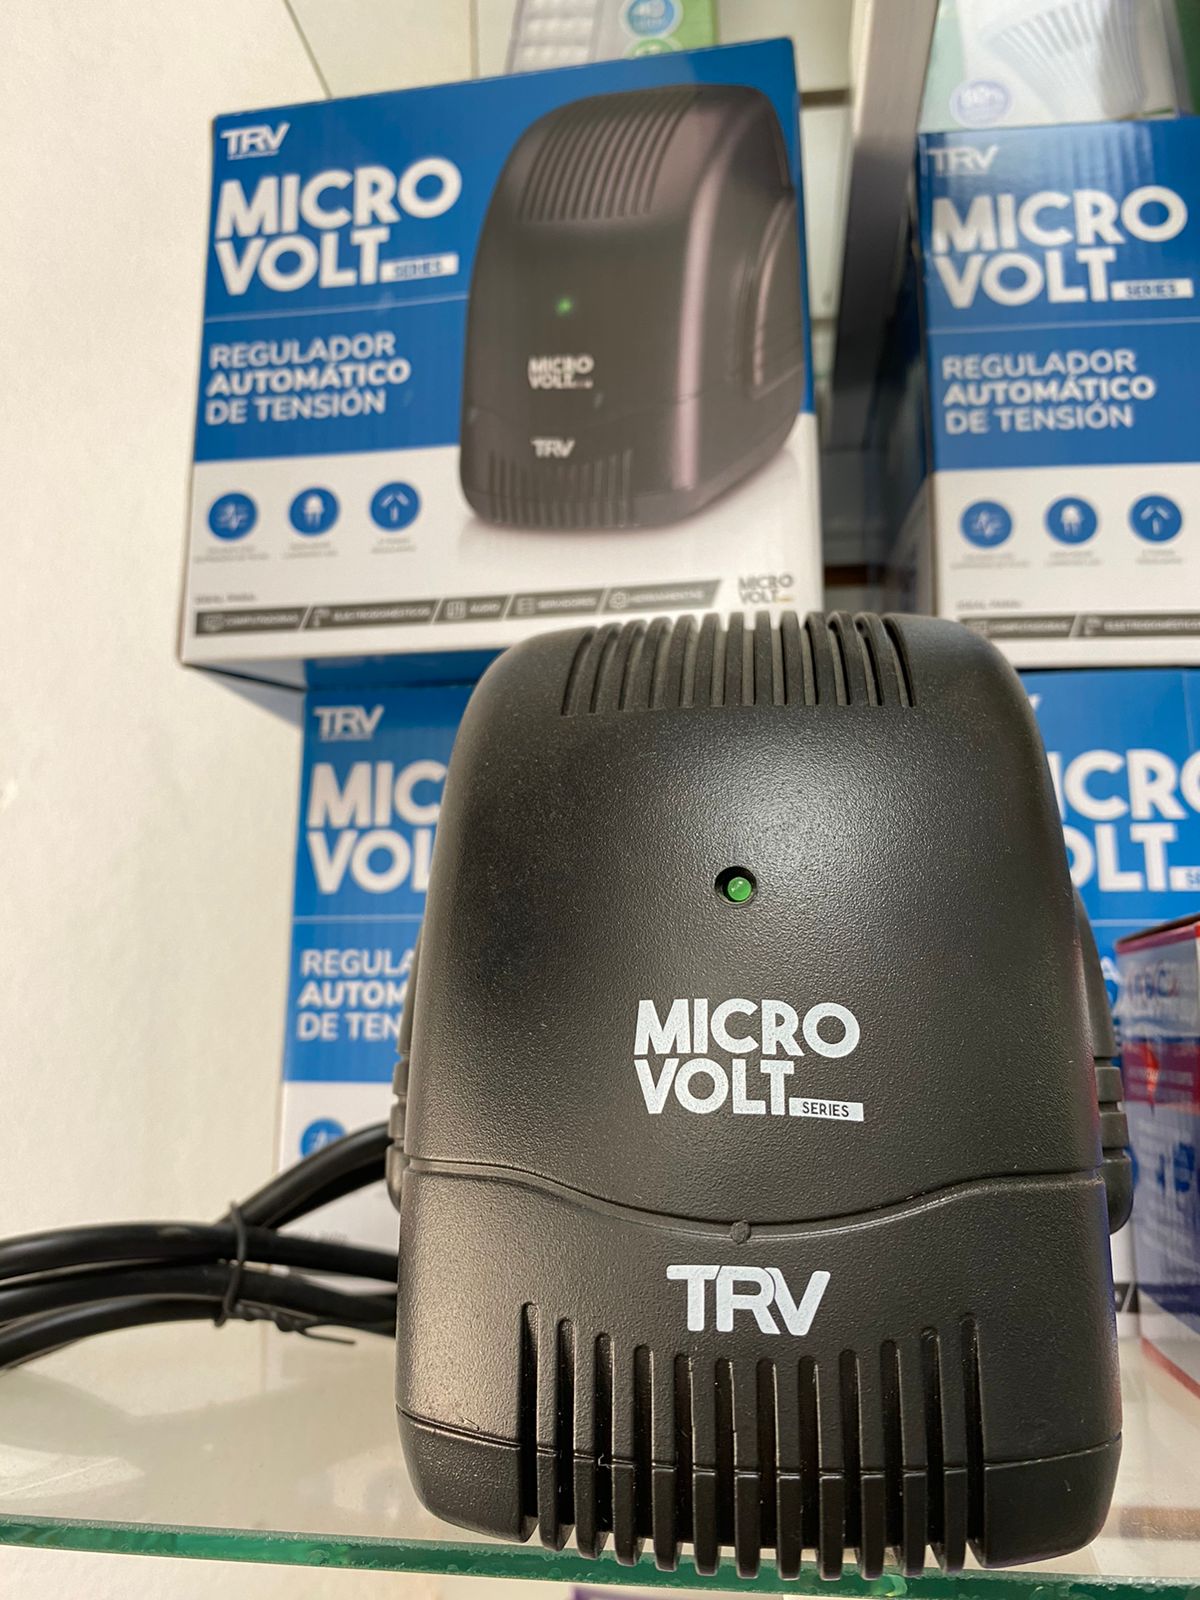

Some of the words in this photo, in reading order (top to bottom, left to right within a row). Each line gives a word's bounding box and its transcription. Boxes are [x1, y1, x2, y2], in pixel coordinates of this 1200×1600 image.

[220, 122, 290, 156] TRV
[928, 145, 998, 172] TRV
[215, 157, 462, 240] MICRO
[932, 185, 1188, 254] MICRO
[214, 226, 390, 295] VOLT
[933, 247, 1116, 309] VOLT
[209, 331, 396, 369] REGULADOR
[528, 355, 594, 374] MICRO
[941, 349, 1136, 380] REGULADOR
[206, 358, 411, 398] AUTOMÁTICO
[943, 373, 1156, 407] AUTOMÁTICO
[205, 399, 247, 425] DE
[254, 388, 386, 422] TENSIÓN
[946, 407, 989, 435] DE
[994, 402, 1133, 432] TENSIÓN
[531, 437, 575, 458] TRV
[314, 705, 385, 736] TRV
[308, 760, 448, 829] MIC
[308, 828, 432, 894] VOL
[302, 948, 415, 977] REGULA
[298, 981, 408, 1009] AUTOM
[297, 1012, 339, 1040] DE
[634, 998, 860, 1058] MICRO
[634, 1058, 795, 1116] VOLT
[801, 1101, 850, 1118] SERIES
[666, 1264, 831, 1337] TRV
